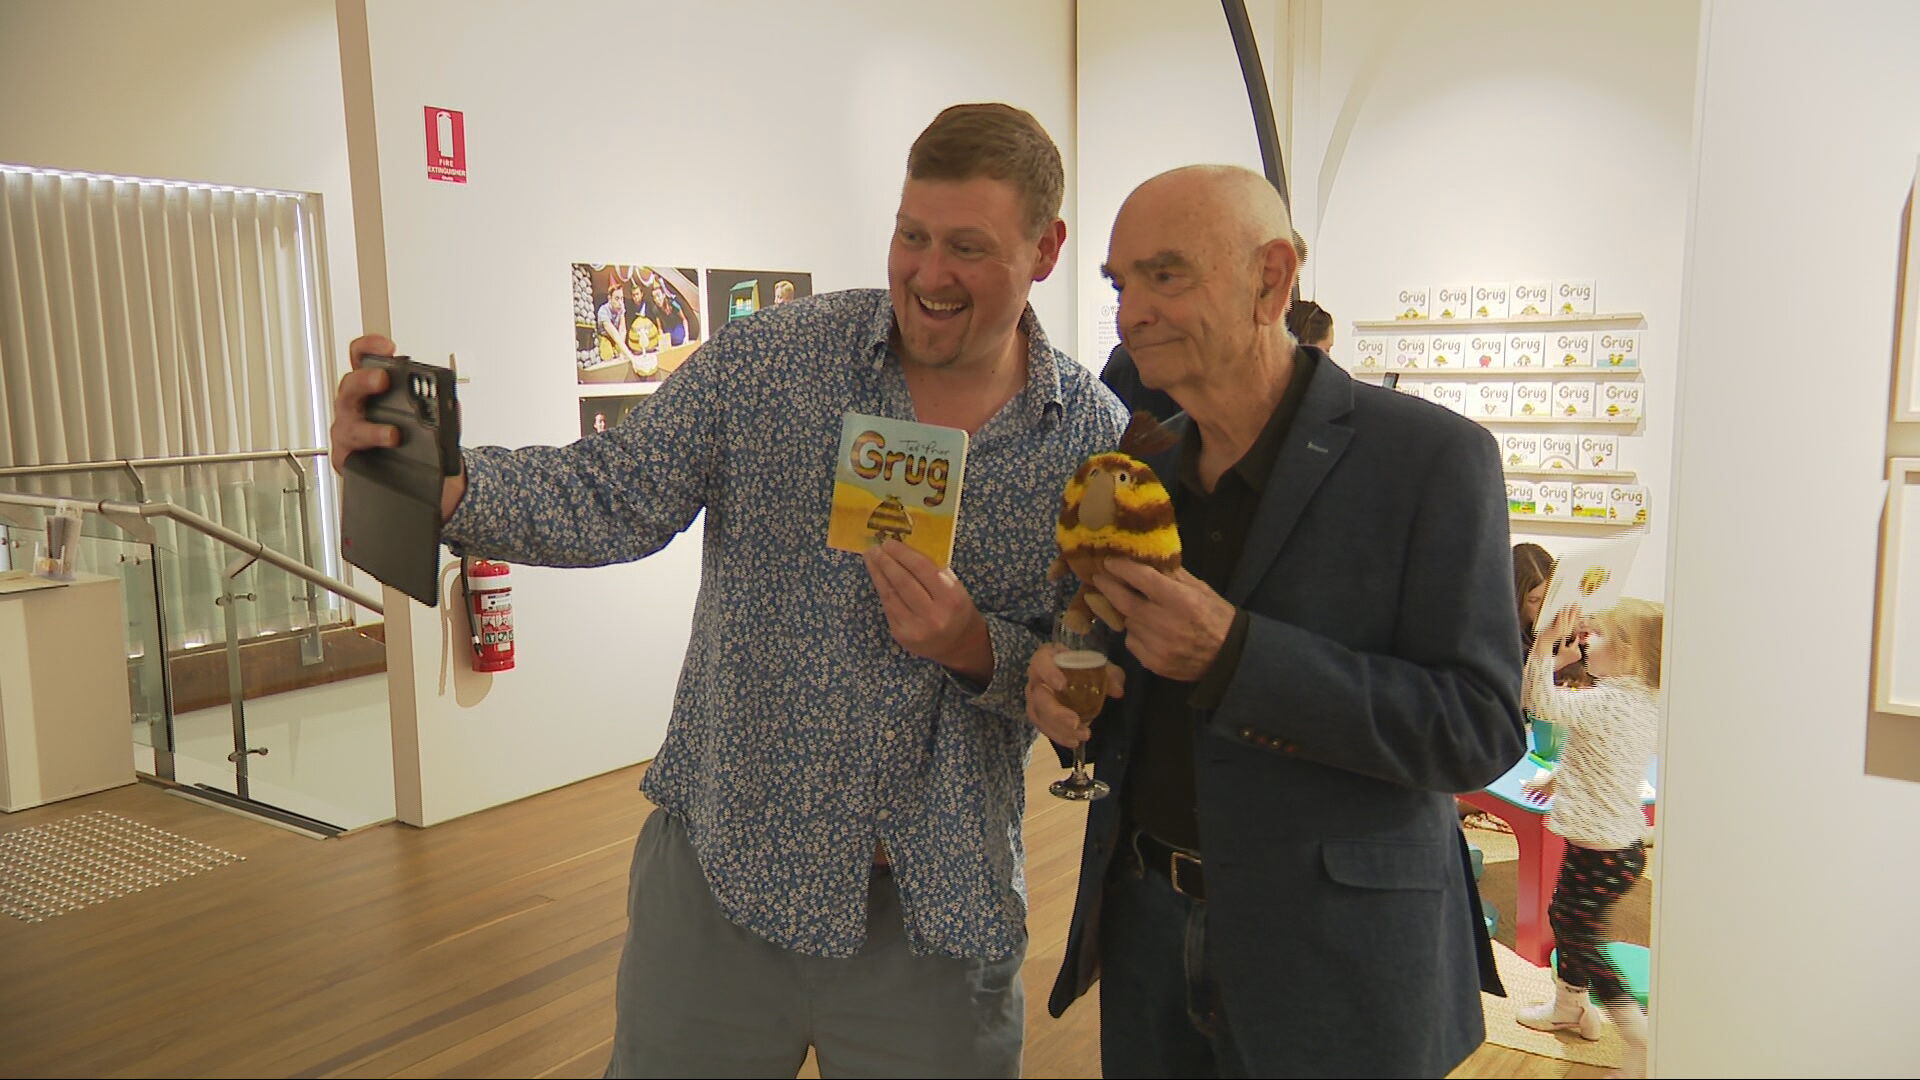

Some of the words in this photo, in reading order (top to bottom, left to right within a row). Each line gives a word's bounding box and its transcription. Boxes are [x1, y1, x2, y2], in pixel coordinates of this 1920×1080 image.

[439, 159, 454, 168] FIRE
[1399, 291, 1425, 307] Grug
[1439, 289, 1467, 306] Grug
[1476, 288, 1505, 305] Grug
[1516, 286, 1546, 303] Grug
[1559, 284, 1590, 301] Grug
[1358, 340, 1383, 355] Grug
[1398, 339, 1425, 355] Grug
[1433, 338, 1461, 354] Grug
[1472, 338, 1501, 354] Grug
[1511, 337, 1540, 354] Grug
[1558, 336, 1588, 354] Grug
[1601, 336, 1633, 353] Grug
[1433, 386, 1461, 402] Grug
[1480, 386, 1508, 402] Grug
[1518, 386, 1546, 402] Grug
[1559, 385, 1589, 402] Grug
[1606, 385, 1638, 402] Grug
[1507, 437, 1536, 454] Grug
[1544, 436, 1571, 453] Grug
[1582, 438, 1613, 456] Grug
[850, 430, 949, 507] Grug
[1506, 484, 1533, 501] Grug
[1539, 486, 1567, 503] Grug
[1574, 487, 1603, 504] Grug
[1611, 488, 1642, 506] Grug
